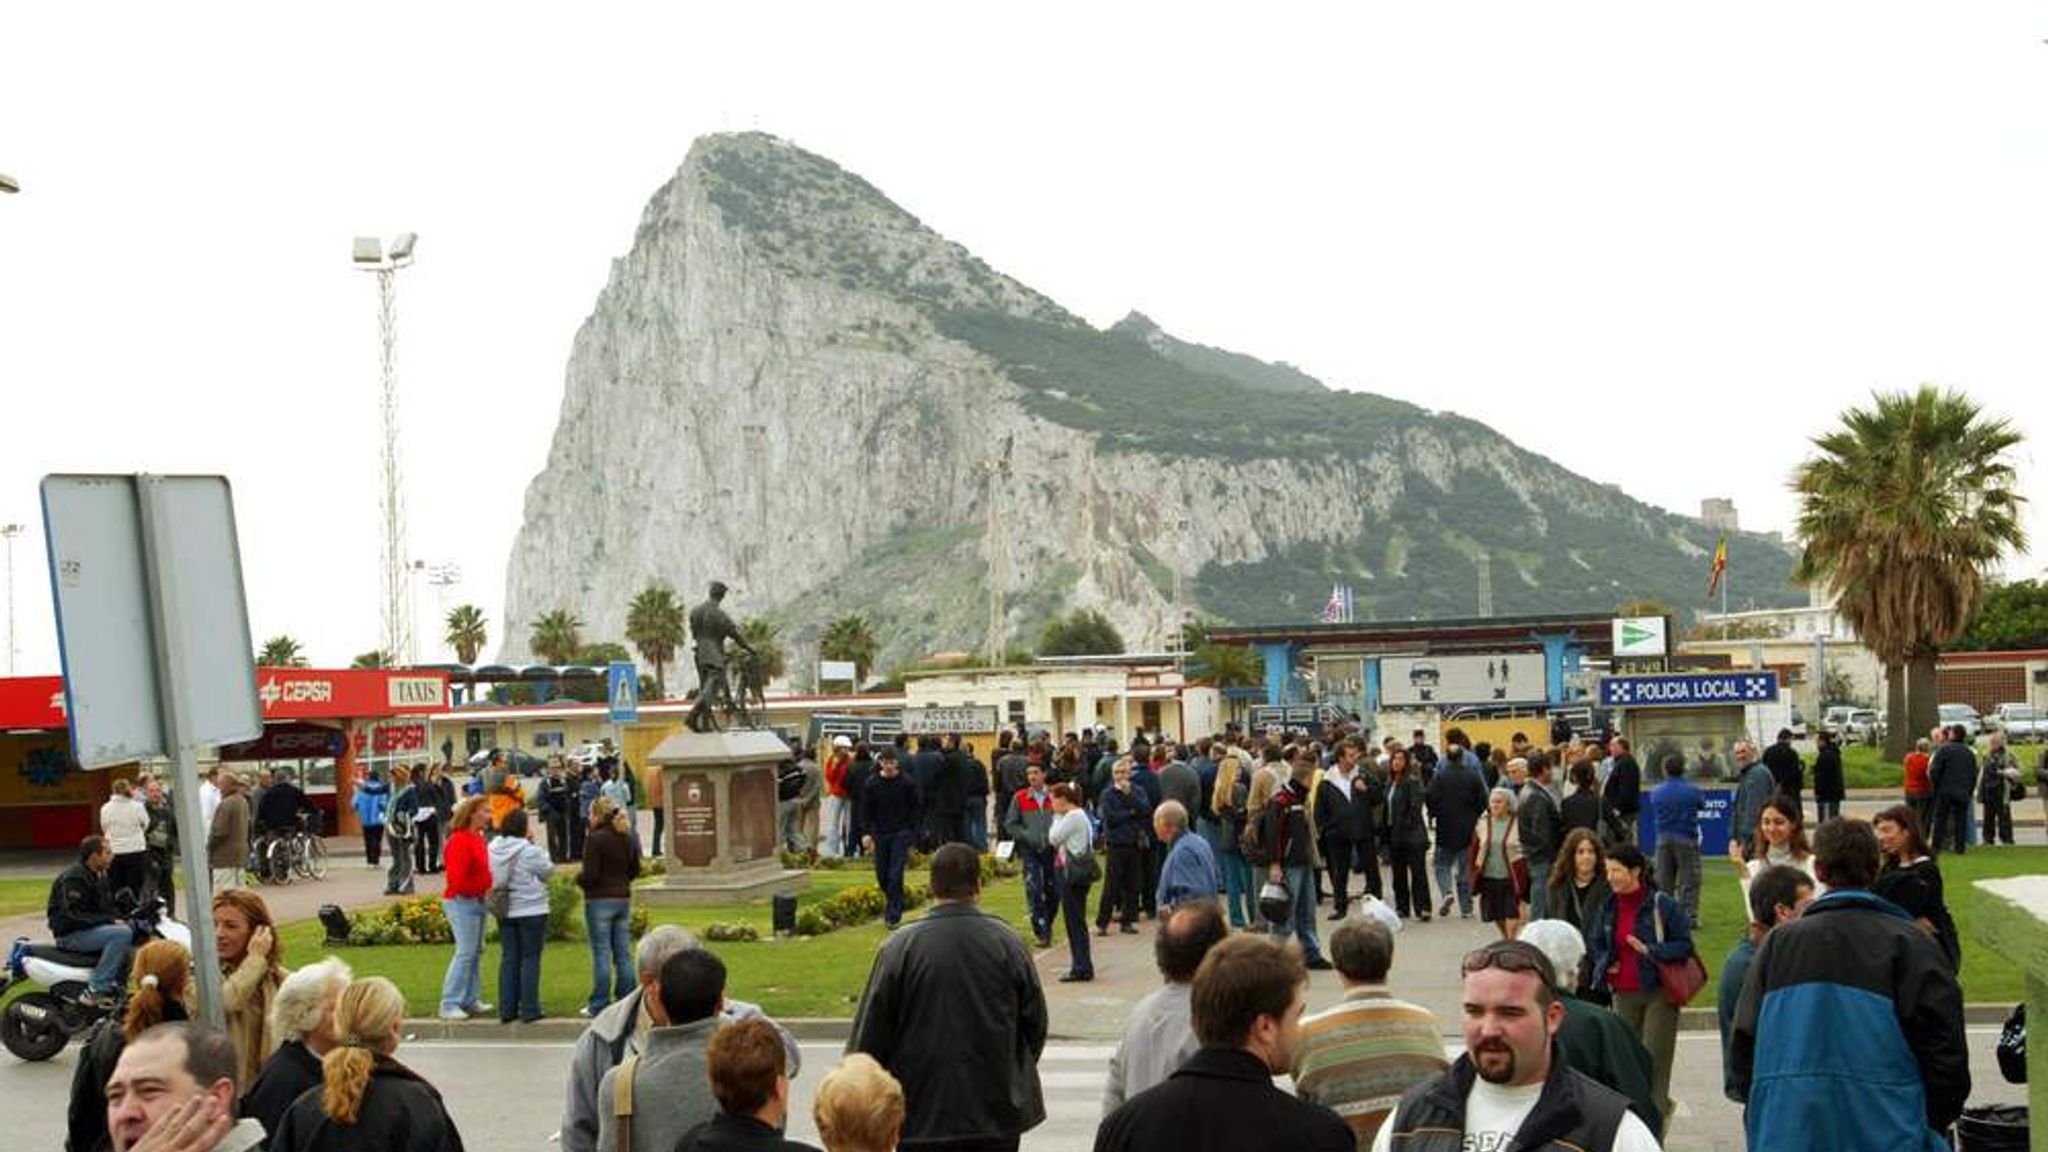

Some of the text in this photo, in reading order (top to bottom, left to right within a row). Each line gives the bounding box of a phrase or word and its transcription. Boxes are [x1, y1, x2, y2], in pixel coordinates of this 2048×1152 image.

[282, 679, 332, 702] CEPSA
[397, 681, 435, 703] TAXIS
[1636, 679, 1740, 700] POLICIA LOCAL
[373, 724, 426, 752] CEPSA
